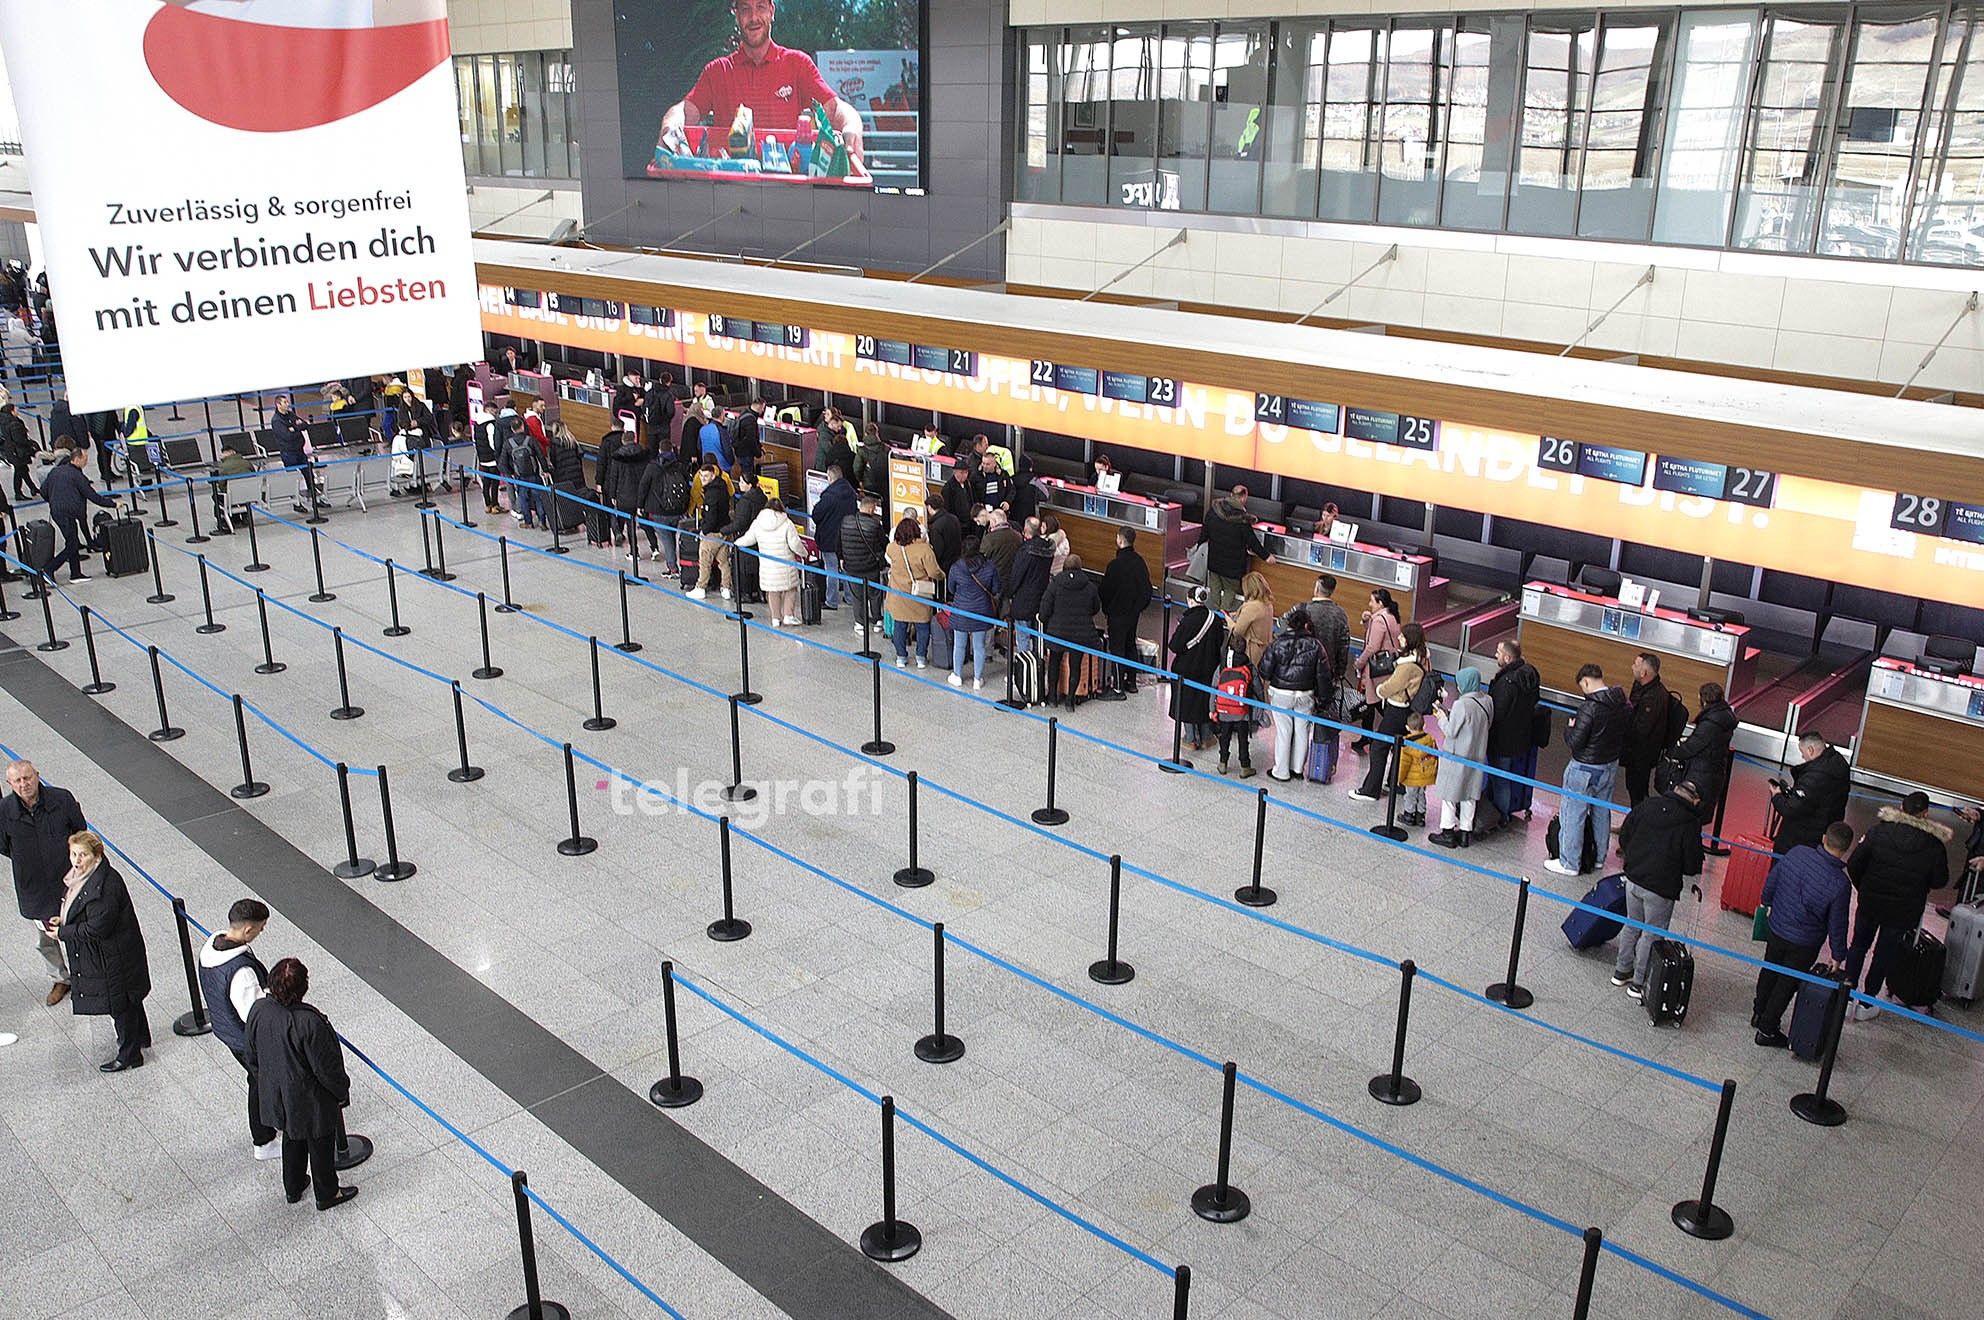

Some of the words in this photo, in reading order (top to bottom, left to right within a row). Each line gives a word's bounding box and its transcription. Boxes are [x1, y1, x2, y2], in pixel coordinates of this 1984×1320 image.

[107, 199, 259, 225] Zuverlässig
[267, 196, 287, 217] &
[293, 190, 412, 219] sorgenfrei
[88, 245, 163, 279] Wir
[172, 233, 358, 273] verbinden
[368, 226, 436, 258] dich
[96, 297, 161, 331] mit
[171, 290, 297, 324] deinen
[307, 277, 447, 311] Liebsten
[505, 286, 516, 303] 14
[548, 291, 560, 309] 15
[606, 300, 618, 315] 16
[655, 307, 667, 323] 17
[710, 314, 723, 333] 18
[787, 325, 801, 344] 19
[857, 335, 874, 356] 20
[953, 350, 969, 371] 21
[1032, 360, 1053, 382] 22
[1151, 377, 1174, 401] 23
[1257, 393, 1282, 418] 24
[1404, 417, 1431, 443] 25
[1542, 436, 1574, 465] 26
[1732, 467, 1770, 499] 27
[1896, 493, 1941, 527] 28
